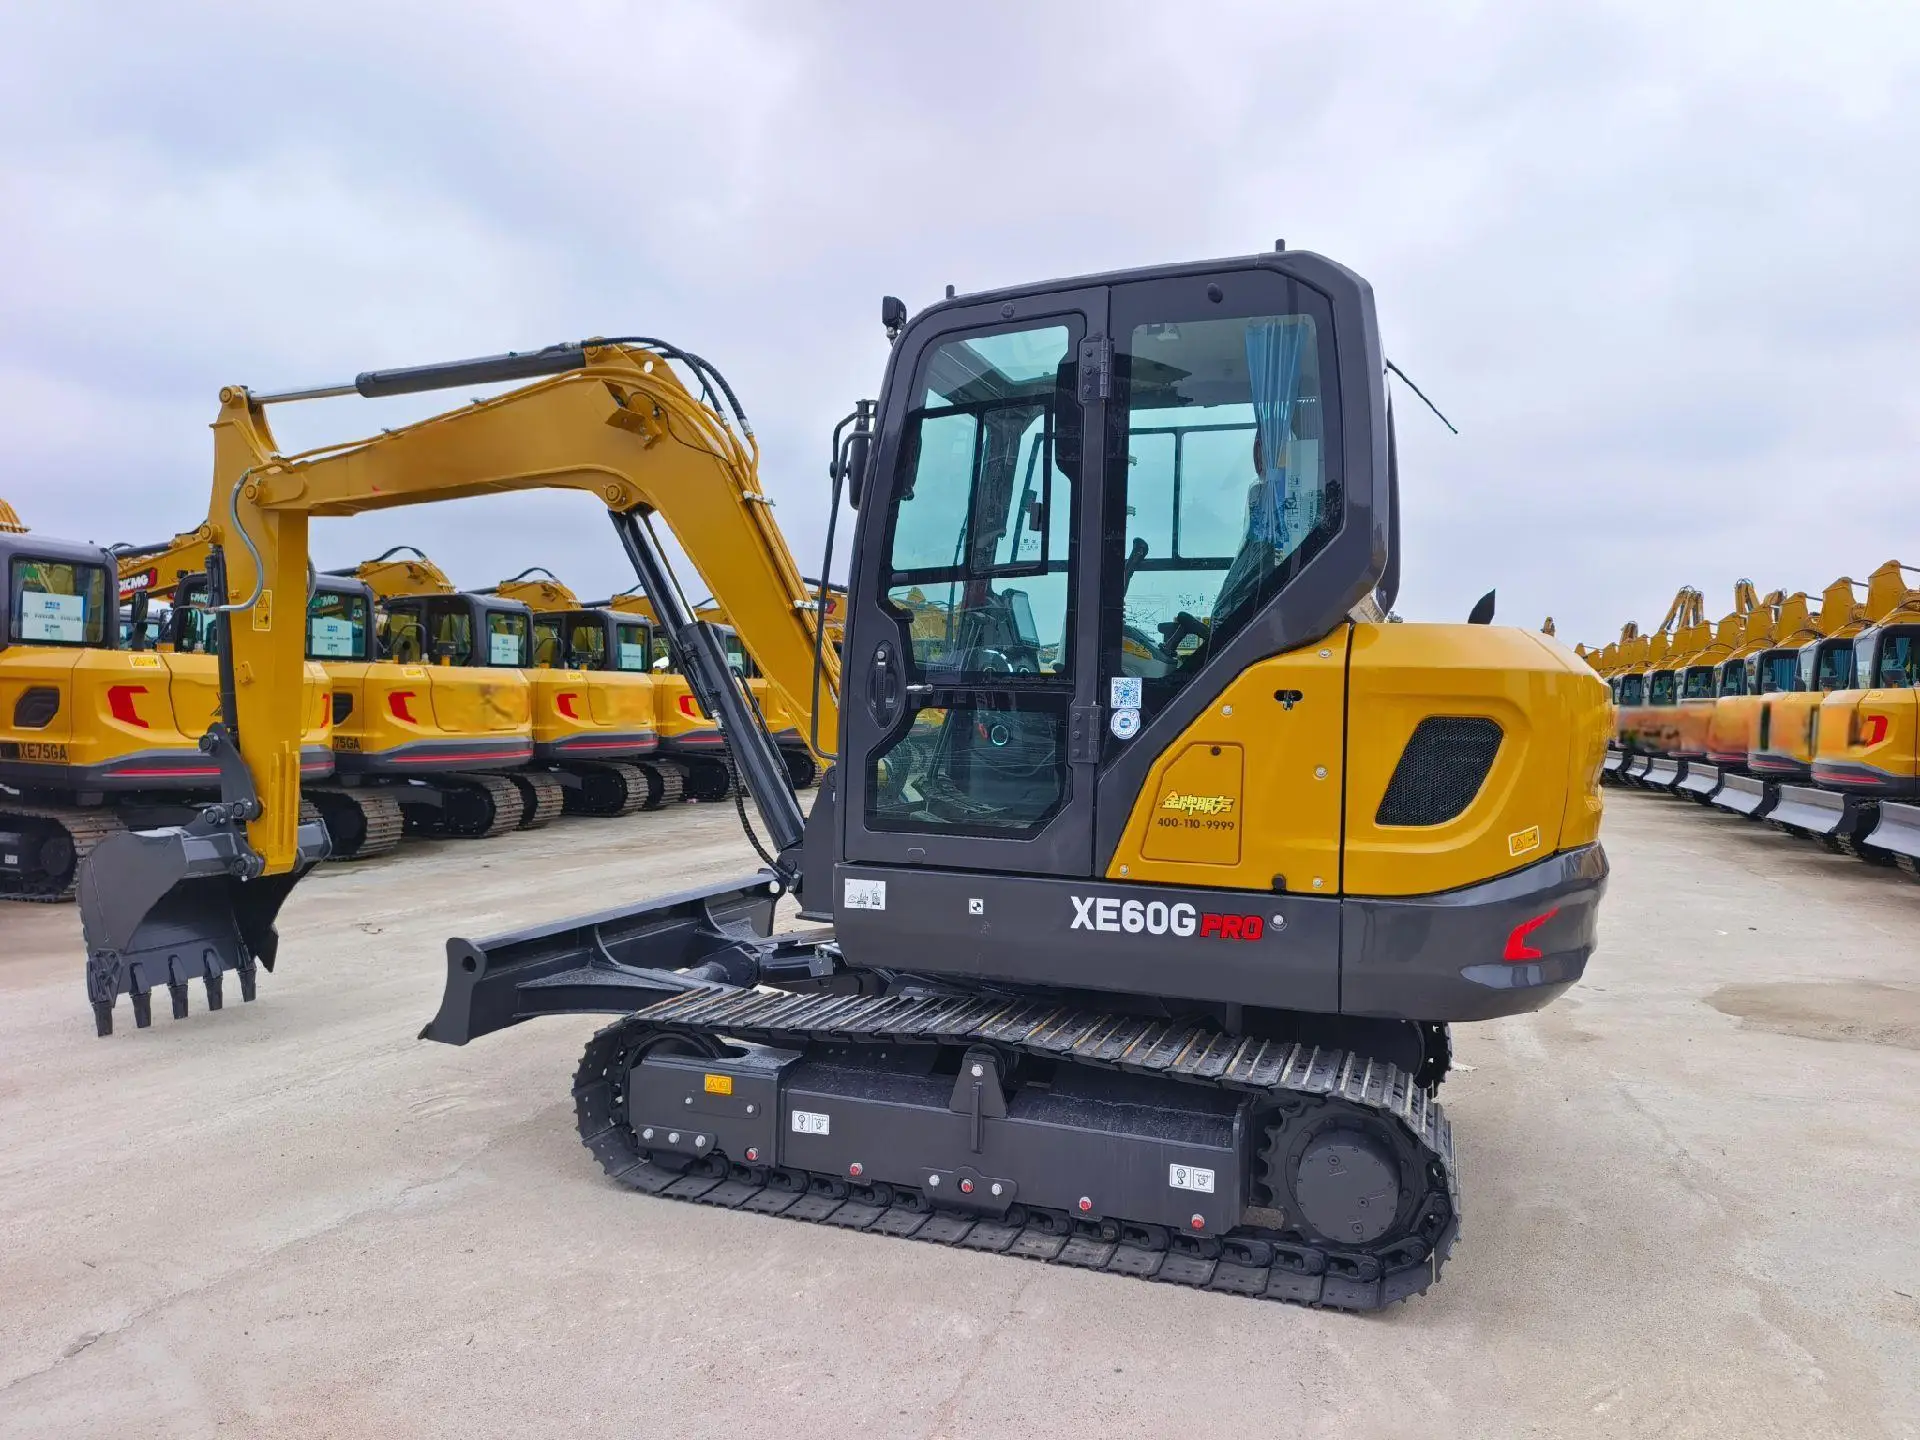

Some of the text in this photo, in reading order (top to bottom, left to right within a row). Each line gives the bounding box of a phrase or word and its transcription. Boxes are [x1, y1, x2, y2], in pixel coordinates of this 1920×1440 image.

[1161, 789, 1235, 816] 金牌服务
[1157, 817, 1235, 831] 400-110-9999
[1070, 895, 1264, 940] XE60G PRO
